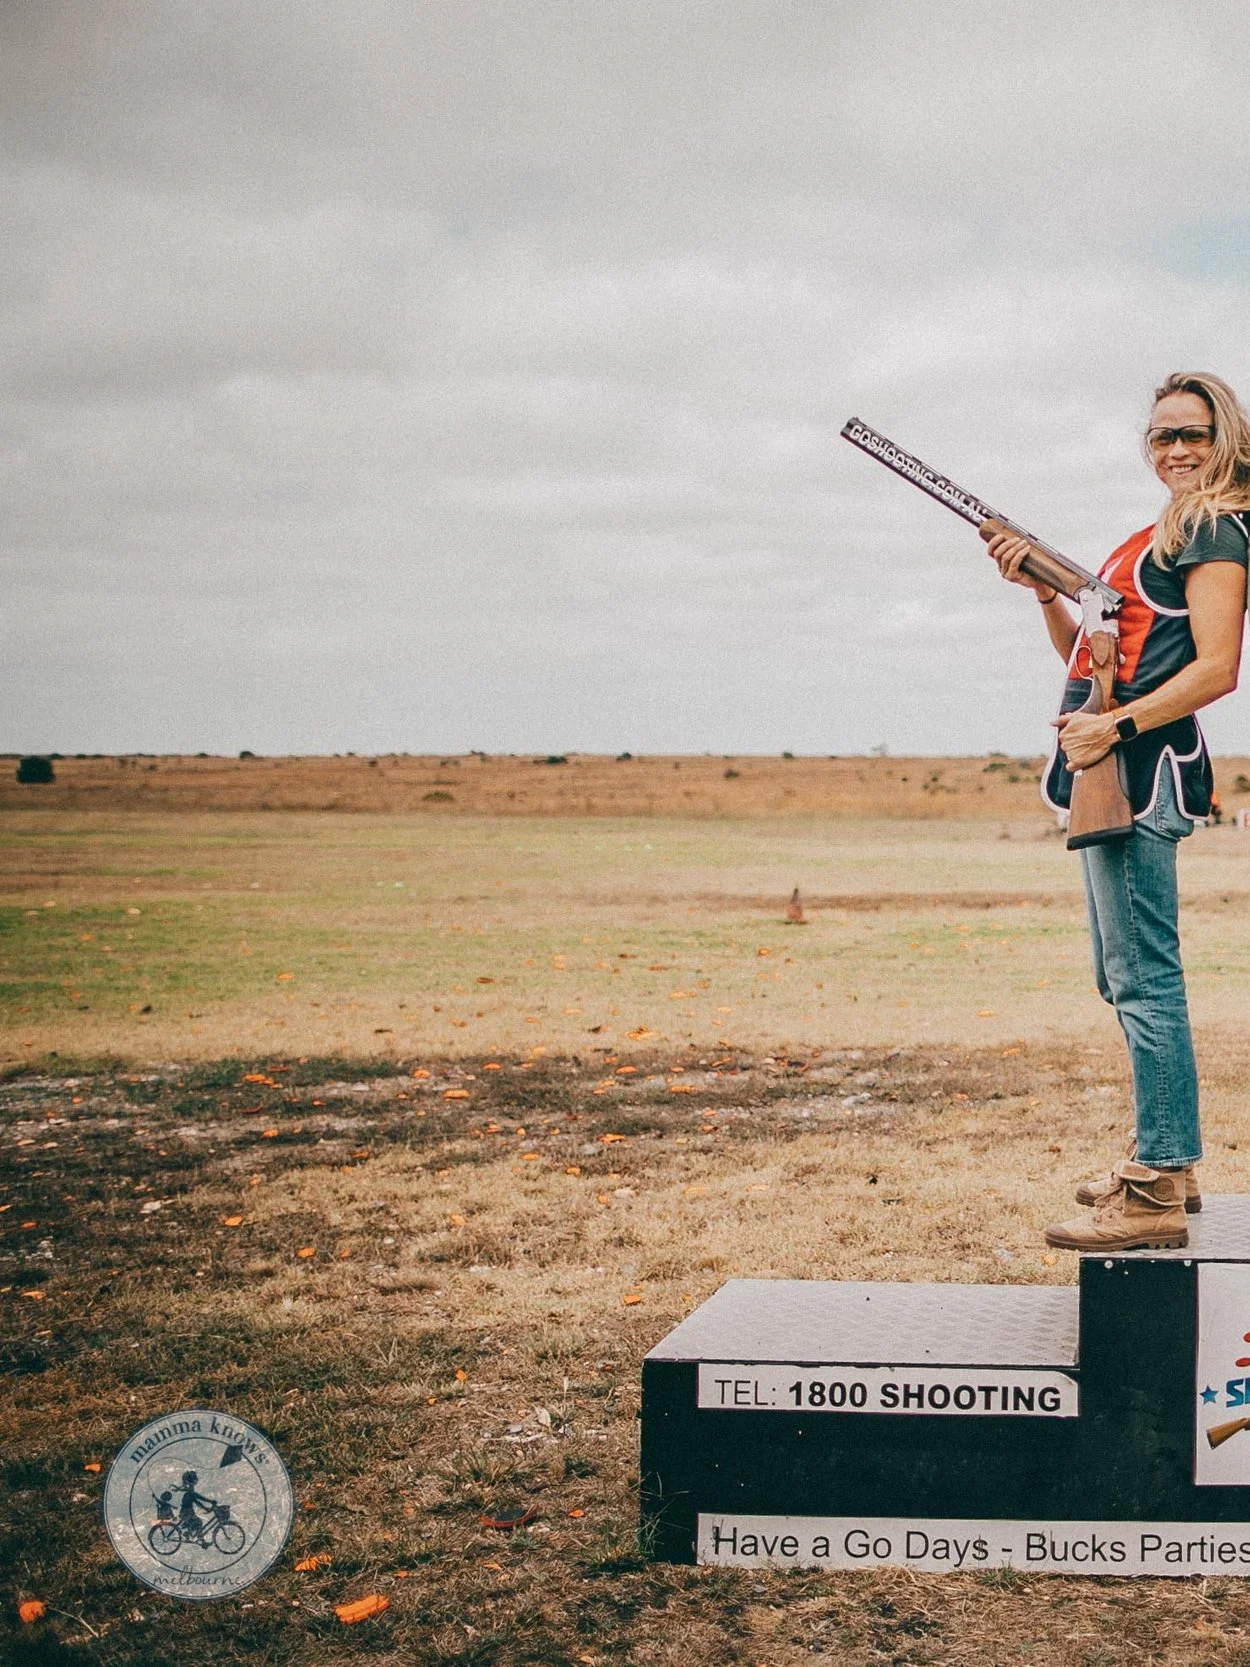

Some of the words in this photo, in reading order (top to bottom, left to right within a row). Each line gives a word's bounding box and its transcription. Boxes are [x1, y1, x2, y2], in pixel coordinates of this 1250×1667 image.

[714, 1379, 776, 1406] TEL:
[788, 1380, 868, 1408] 1800
[880, 1382, 1062, 1412] SHOOTING
[713, 1526, 799, 1557] Have
[812, 1535, 830, 1558] a
[844, 1529, 892, 1559] Go
[906, 1530, 989, 1568] Days
[1026, 1532, 1126, 1563] Bucks
